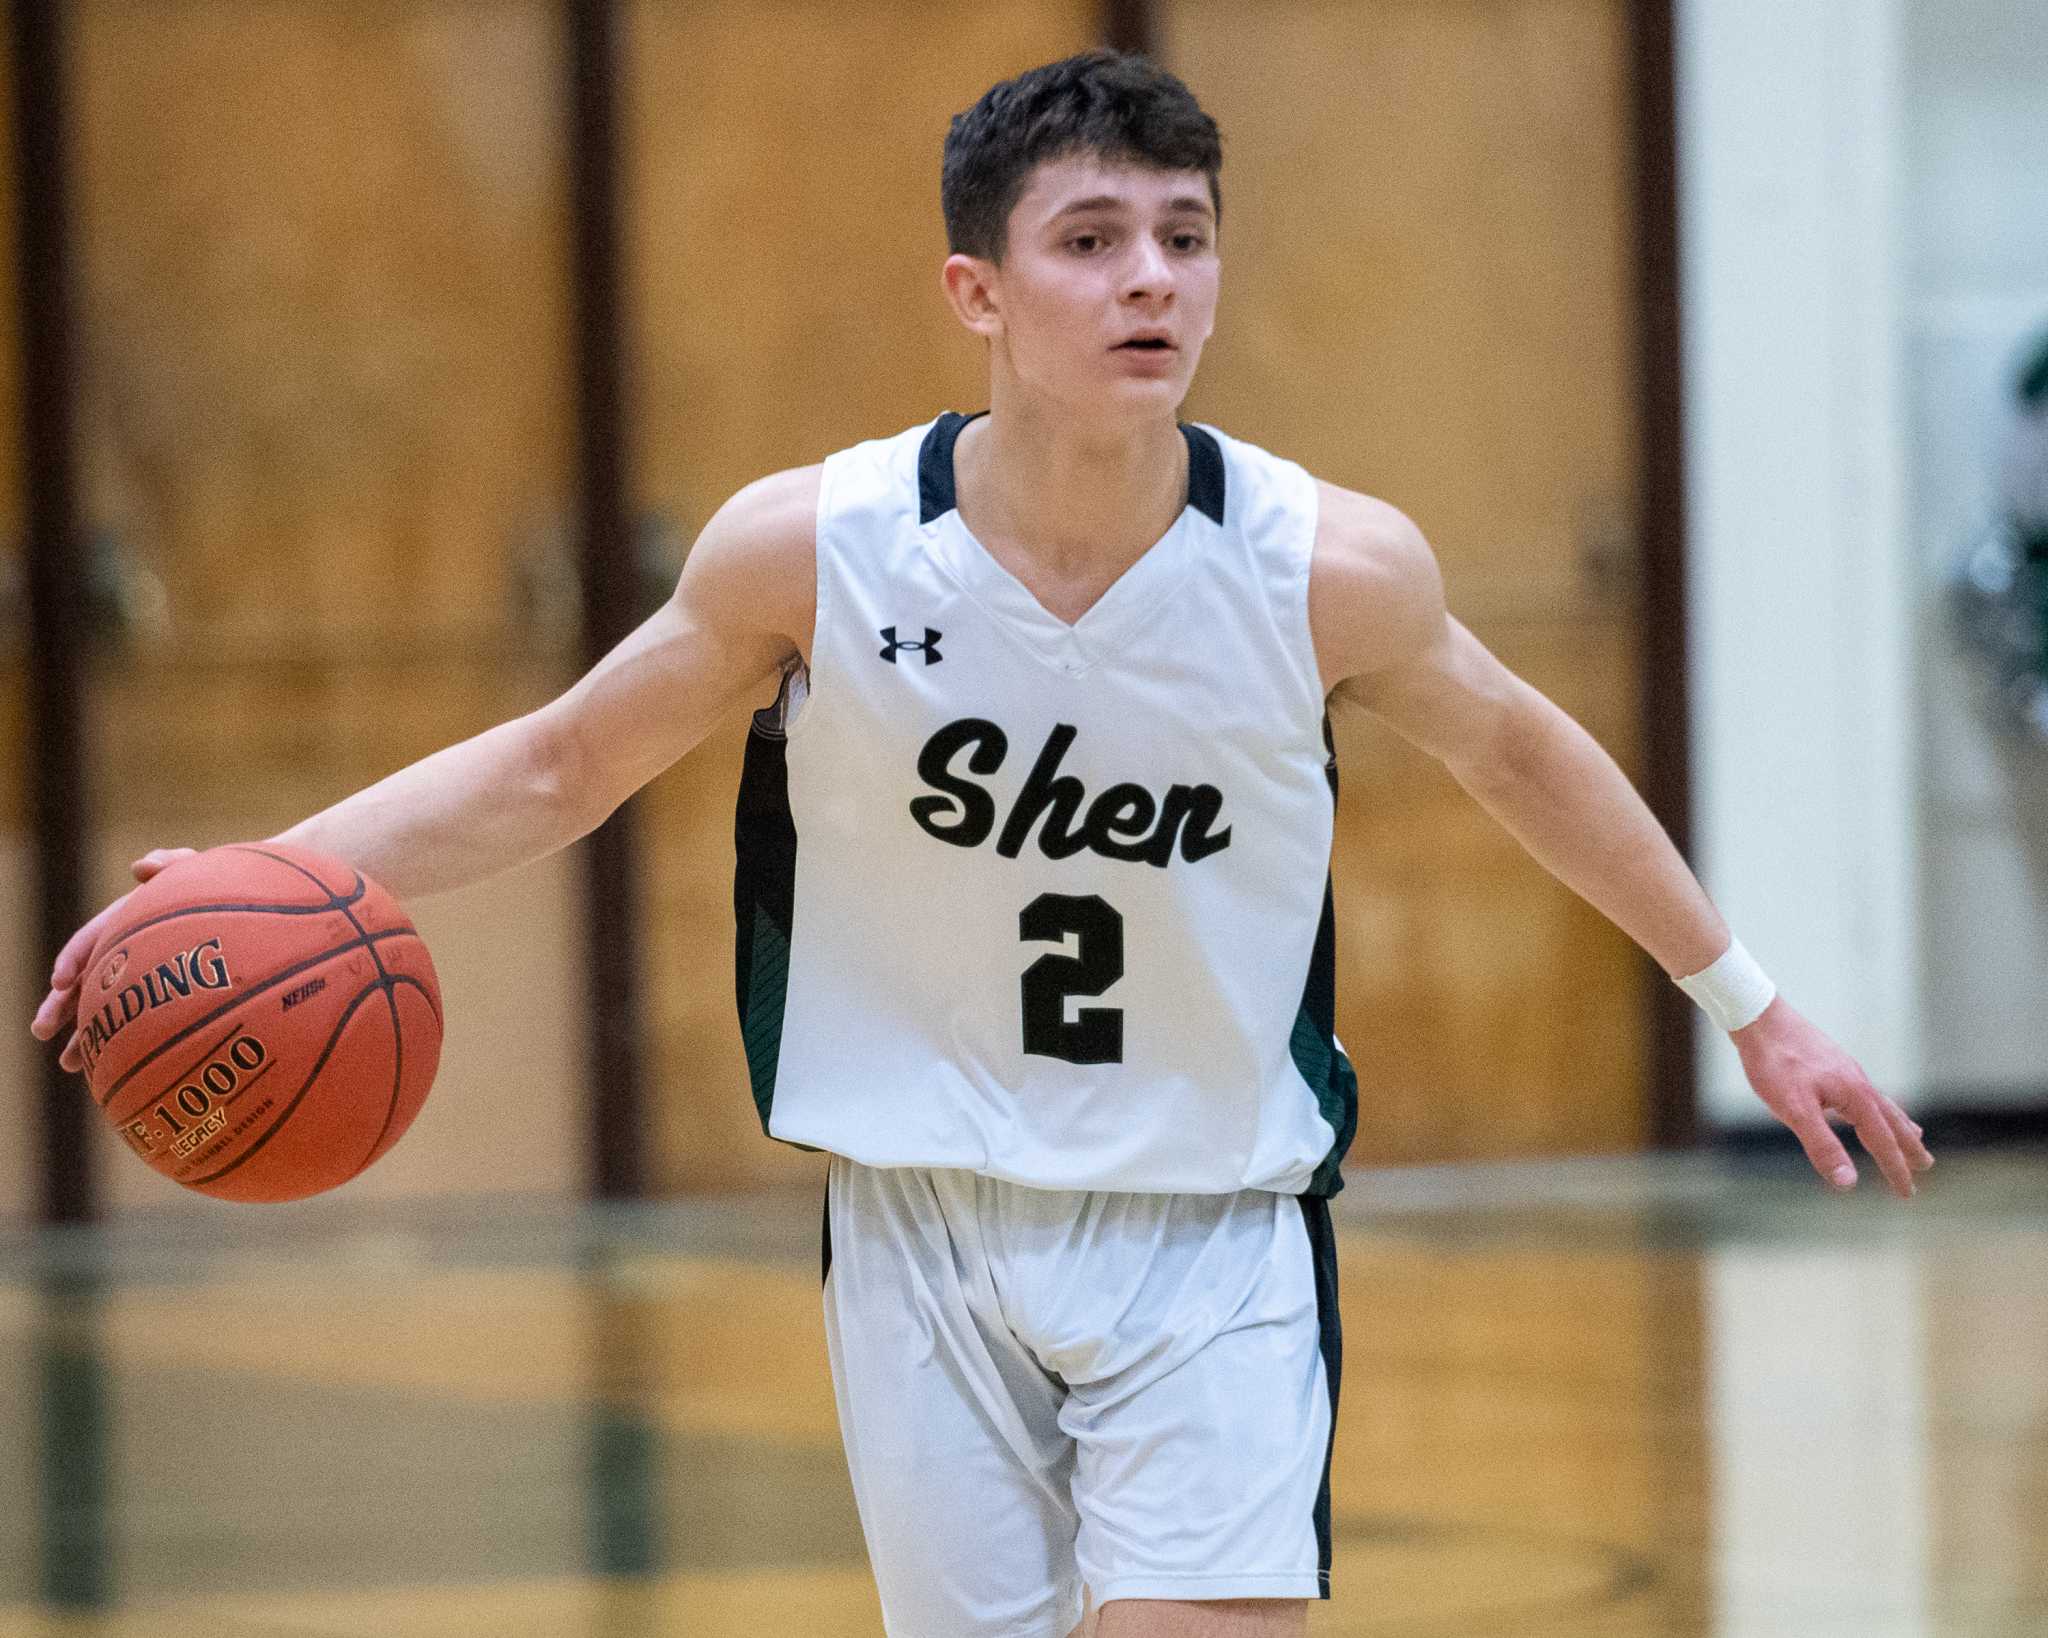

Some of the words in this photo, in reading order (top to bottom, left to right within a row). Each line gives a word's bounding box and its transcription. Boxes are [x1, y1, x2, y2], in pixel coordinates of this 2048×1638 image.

[909, 717, 1232, 868] Shen
[1019, 892, 1124, 1065] 2
[170, 1106, 228, 1159] LEGACY
